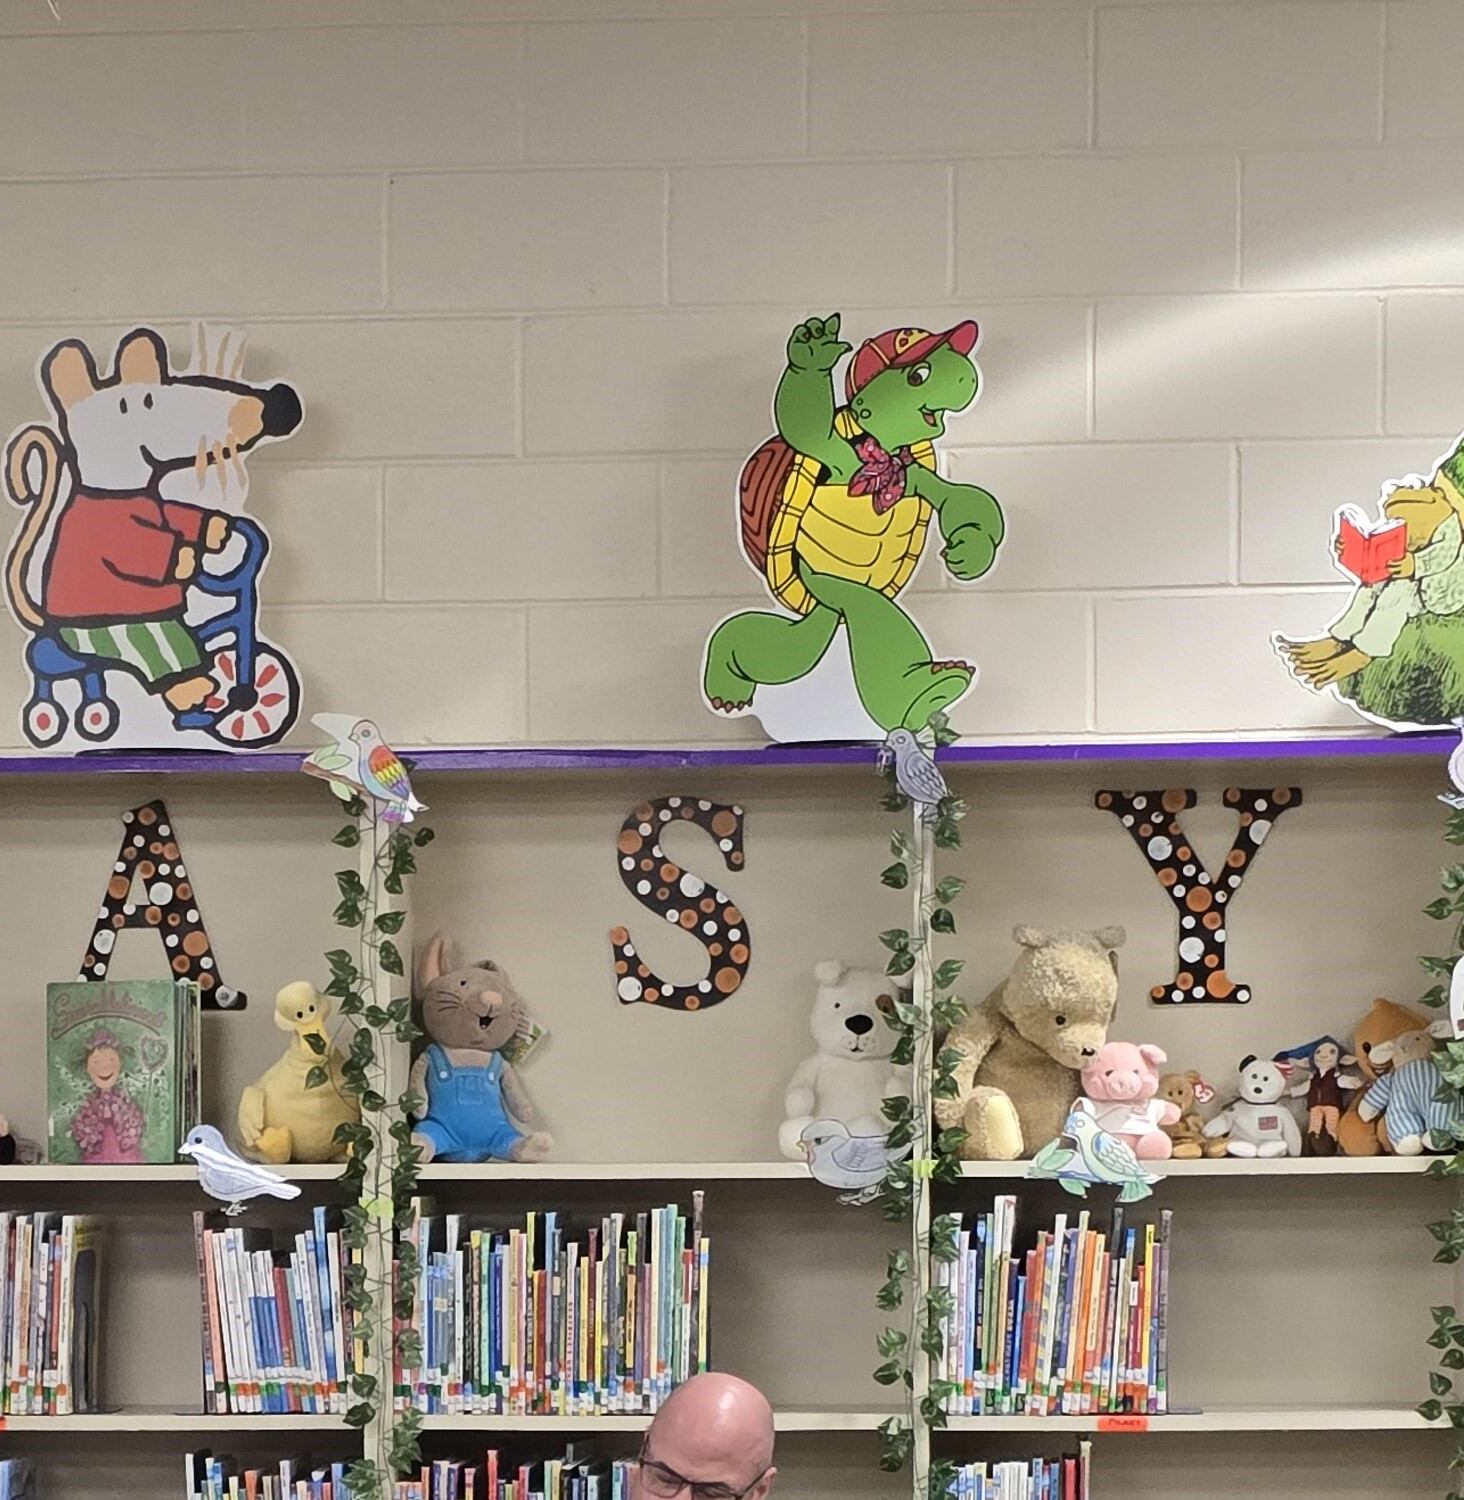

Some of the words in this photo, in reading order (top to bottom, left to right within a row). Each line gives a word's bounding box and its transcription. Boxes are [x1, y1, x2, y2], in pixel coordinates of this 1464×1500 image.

[77, 799, 248, 1010] A
[611, 797, 751, 1011] S
[1095, 787, 1302, 1004] Y
